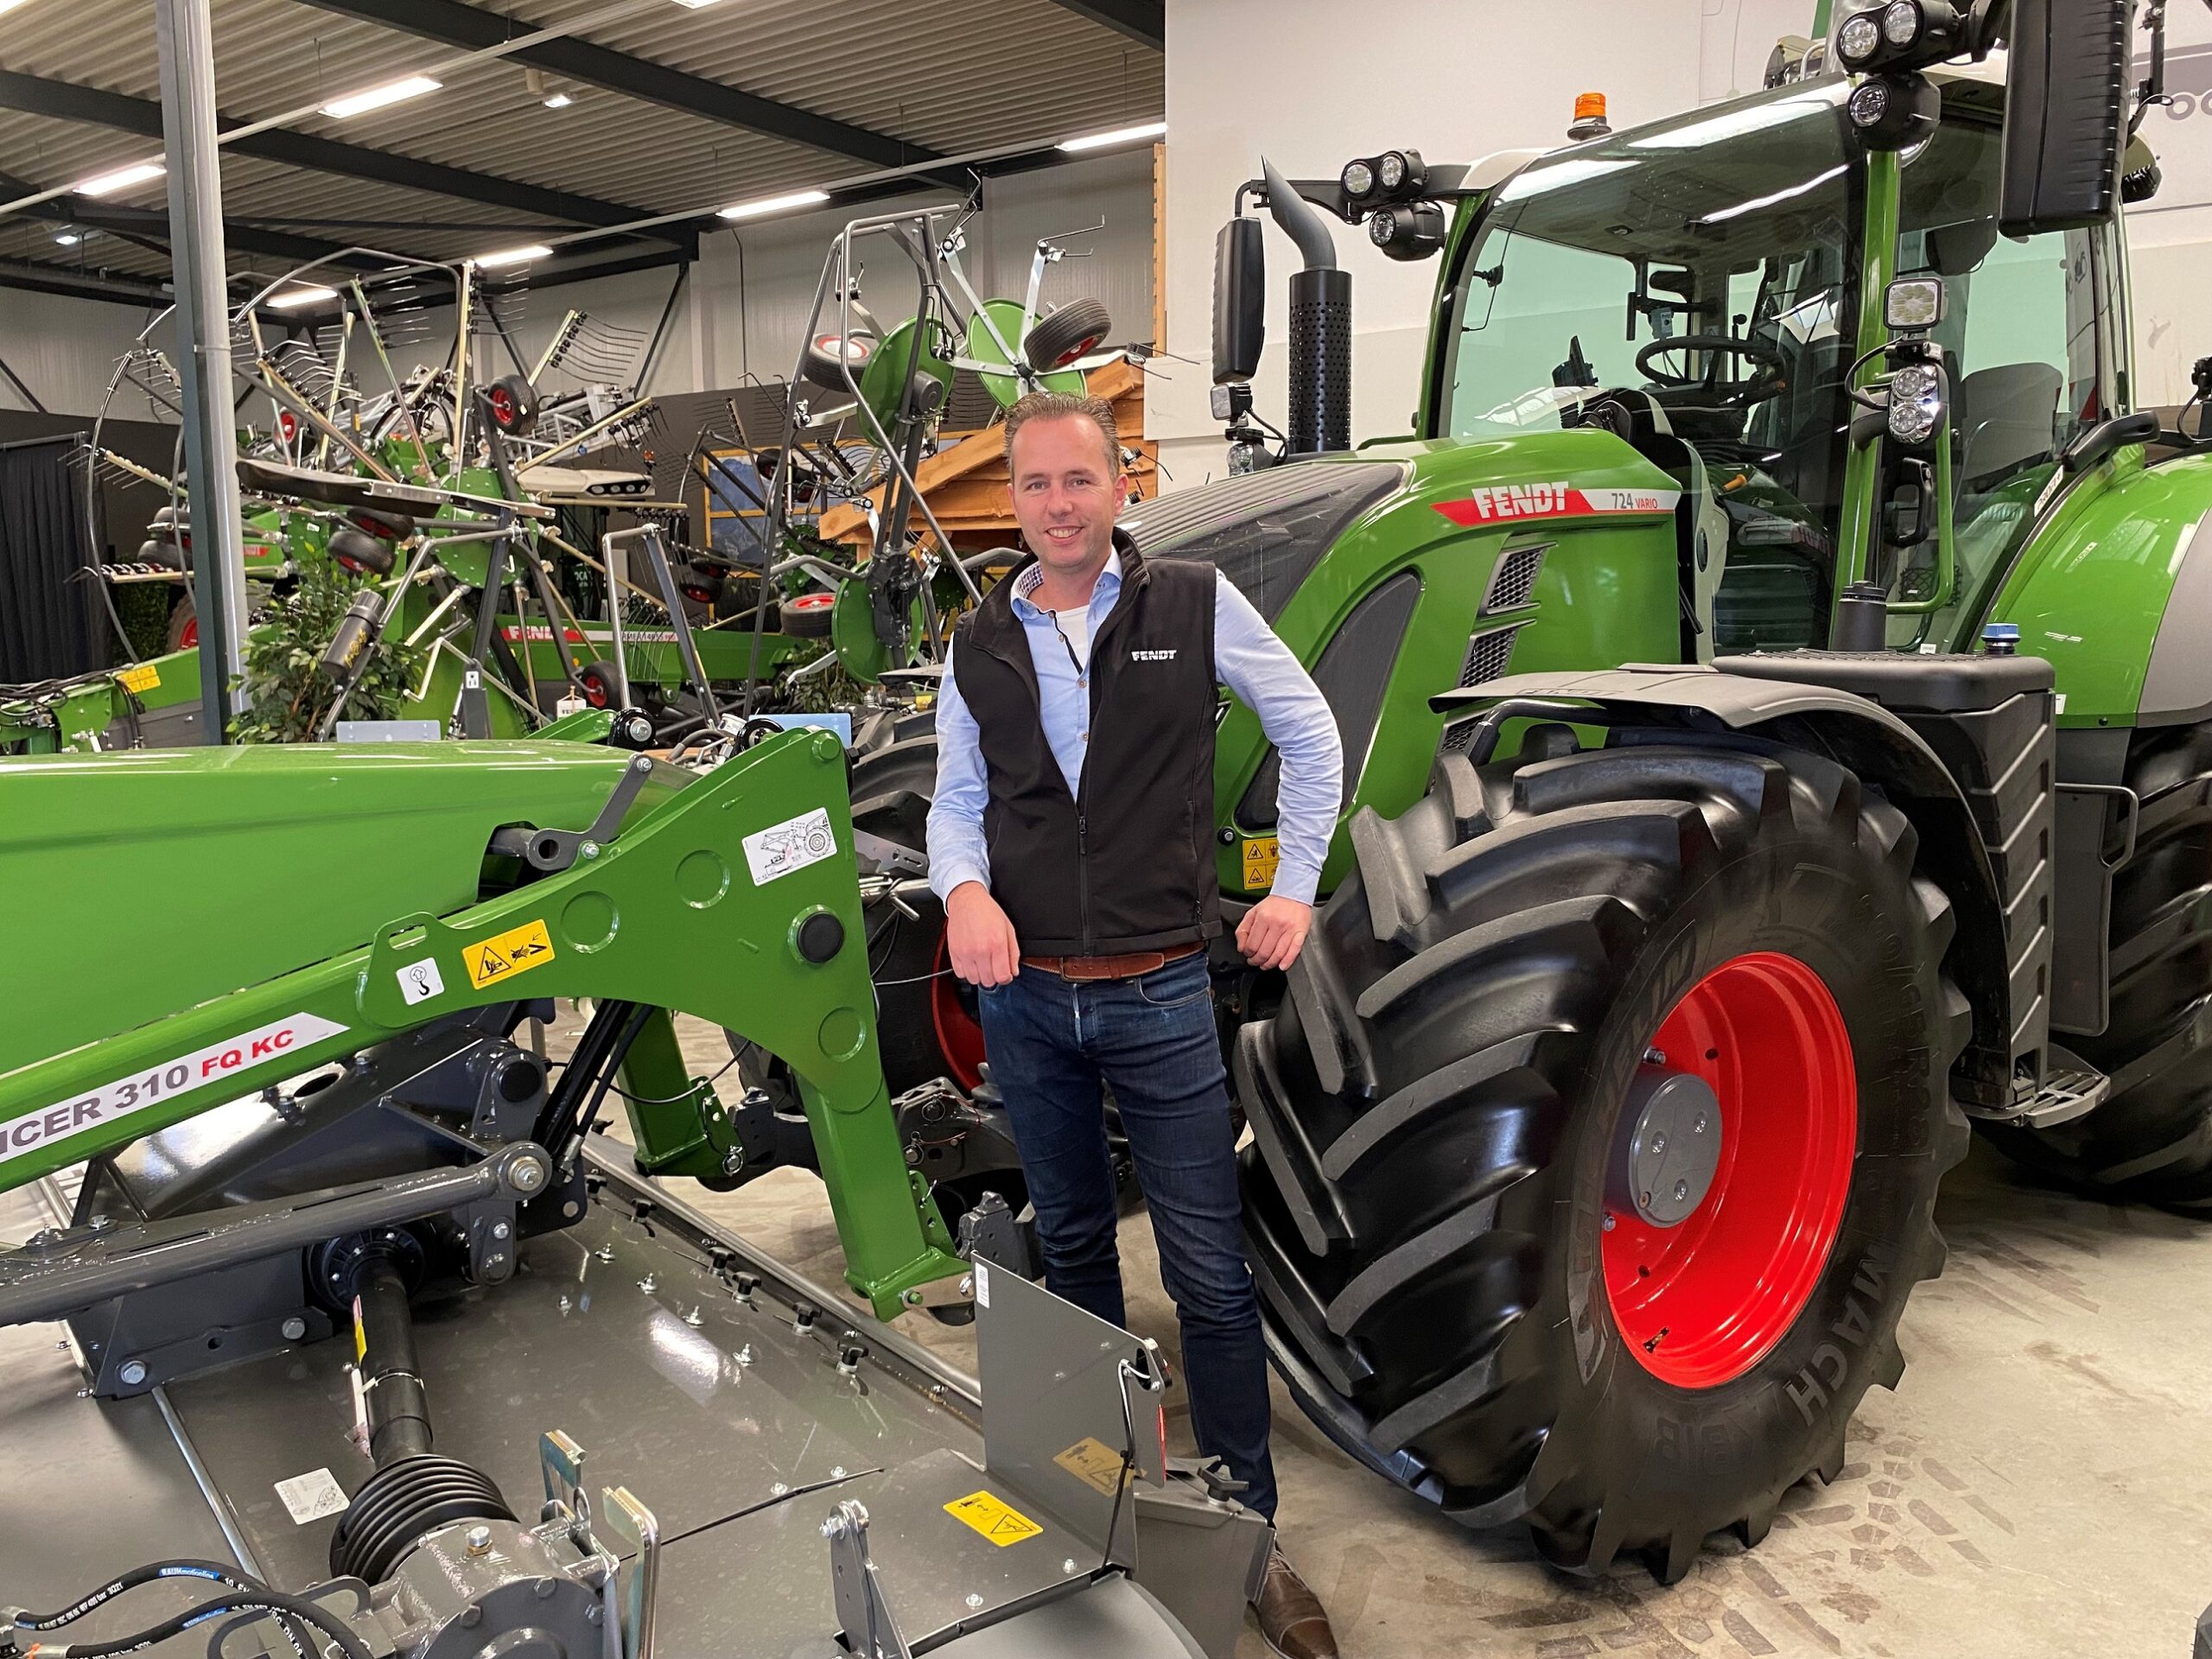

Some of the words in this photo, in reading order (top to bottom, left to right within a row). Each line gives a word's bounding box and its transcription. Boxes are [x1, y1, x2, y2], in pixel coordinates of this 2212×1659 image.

[1471, 481, 1569, 518] FENDT
[1611, 493, 1634, 509] 724
[1636, 498, 1659, 509] VARIO
[1131, 649, 1177, 661] FENDT
[115, 1065, 189, 1109] 310
[201, 1049, 243, 1078] FQ
[251, 1029, 295, 1059] KC
[1783, 1242, 1899, 1427] MACH
